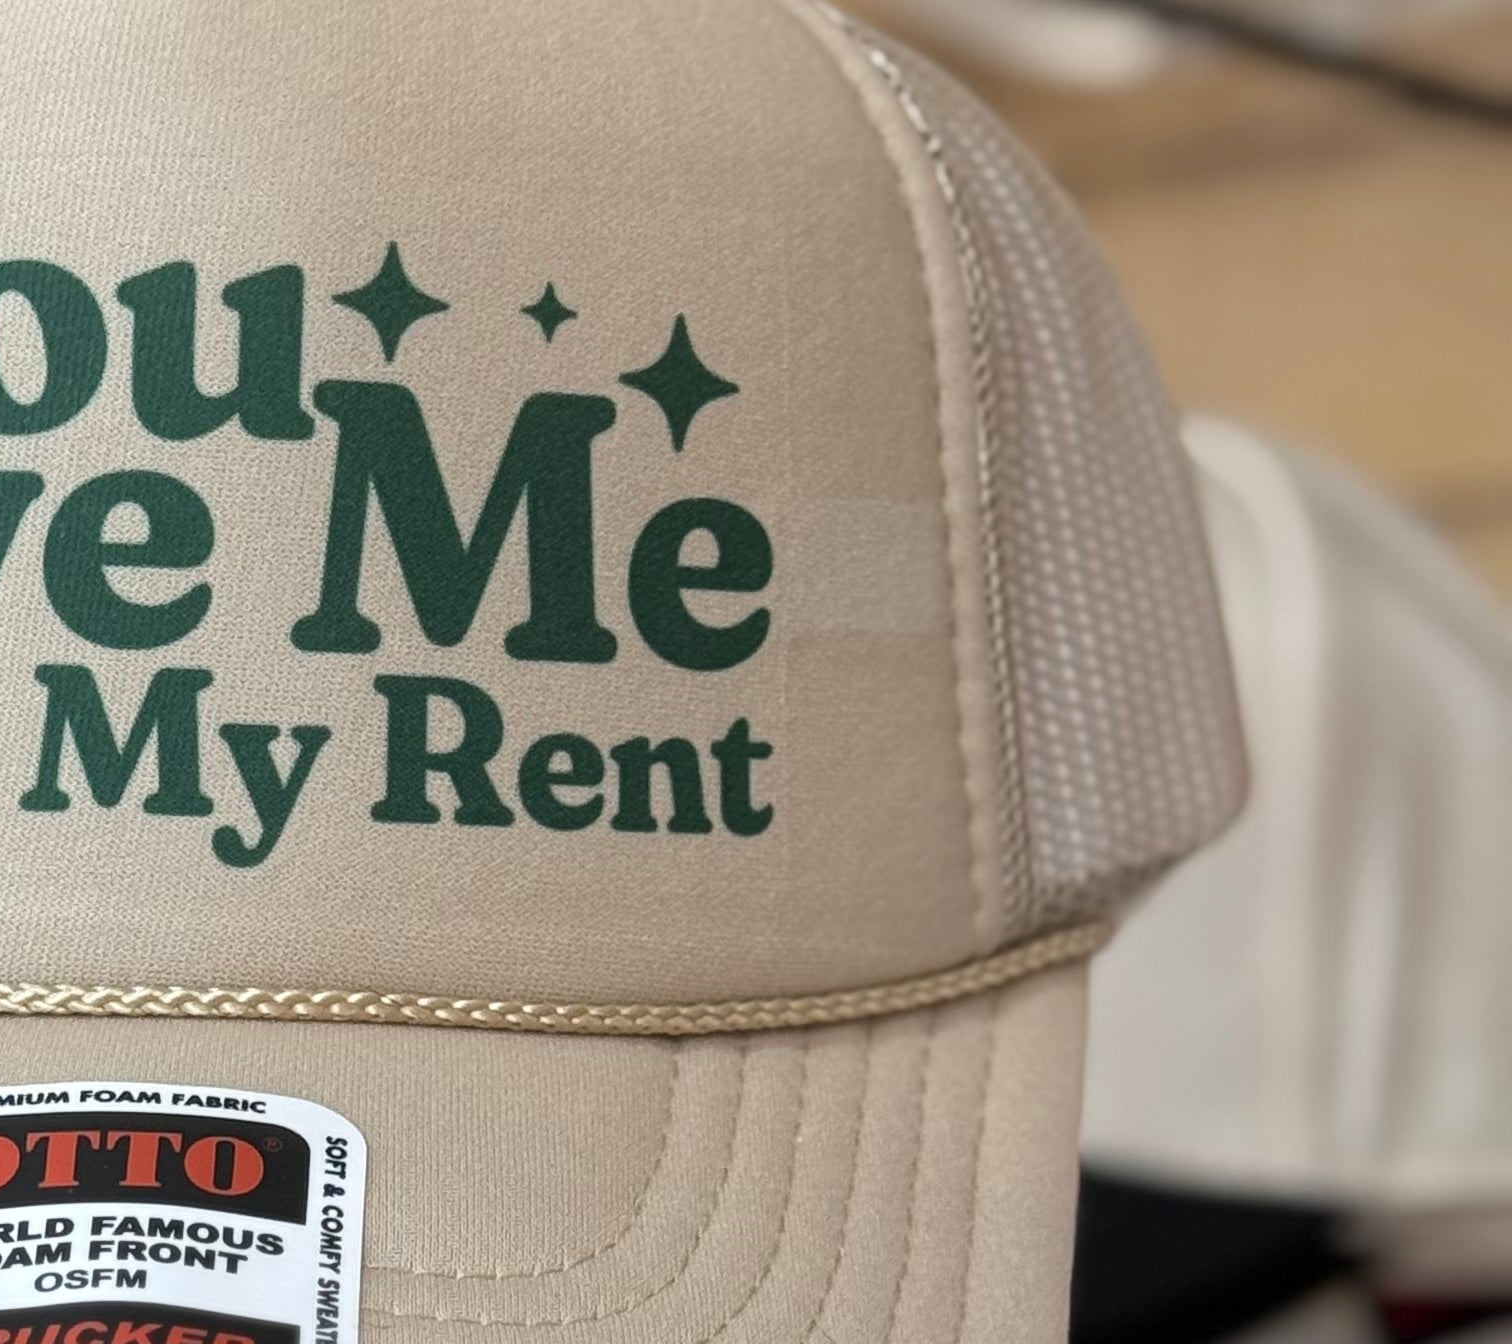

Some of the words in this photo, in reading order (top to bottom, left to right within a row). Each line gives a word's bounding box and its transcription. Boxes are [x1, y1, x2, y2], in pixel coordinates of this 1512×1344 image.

[289, 378, 774, 672] Me
[19, 663, 332, 869] My
[371, 672, 775, 838] Rent
[80, 1090, 161, 1104] FOAM
[172, 1093, 267, 1114] FABRIC
[325, 1136, 348, 1180] SOFT
[323, 1184, 345, 1198] &
[90, 1216, 284, 1256] FAMOUS
[318, 1205, 345, 1274] COMFY
[88, 1240, 248, 1274] FRONT
[34, 1268, 148, 1292] OSFM
